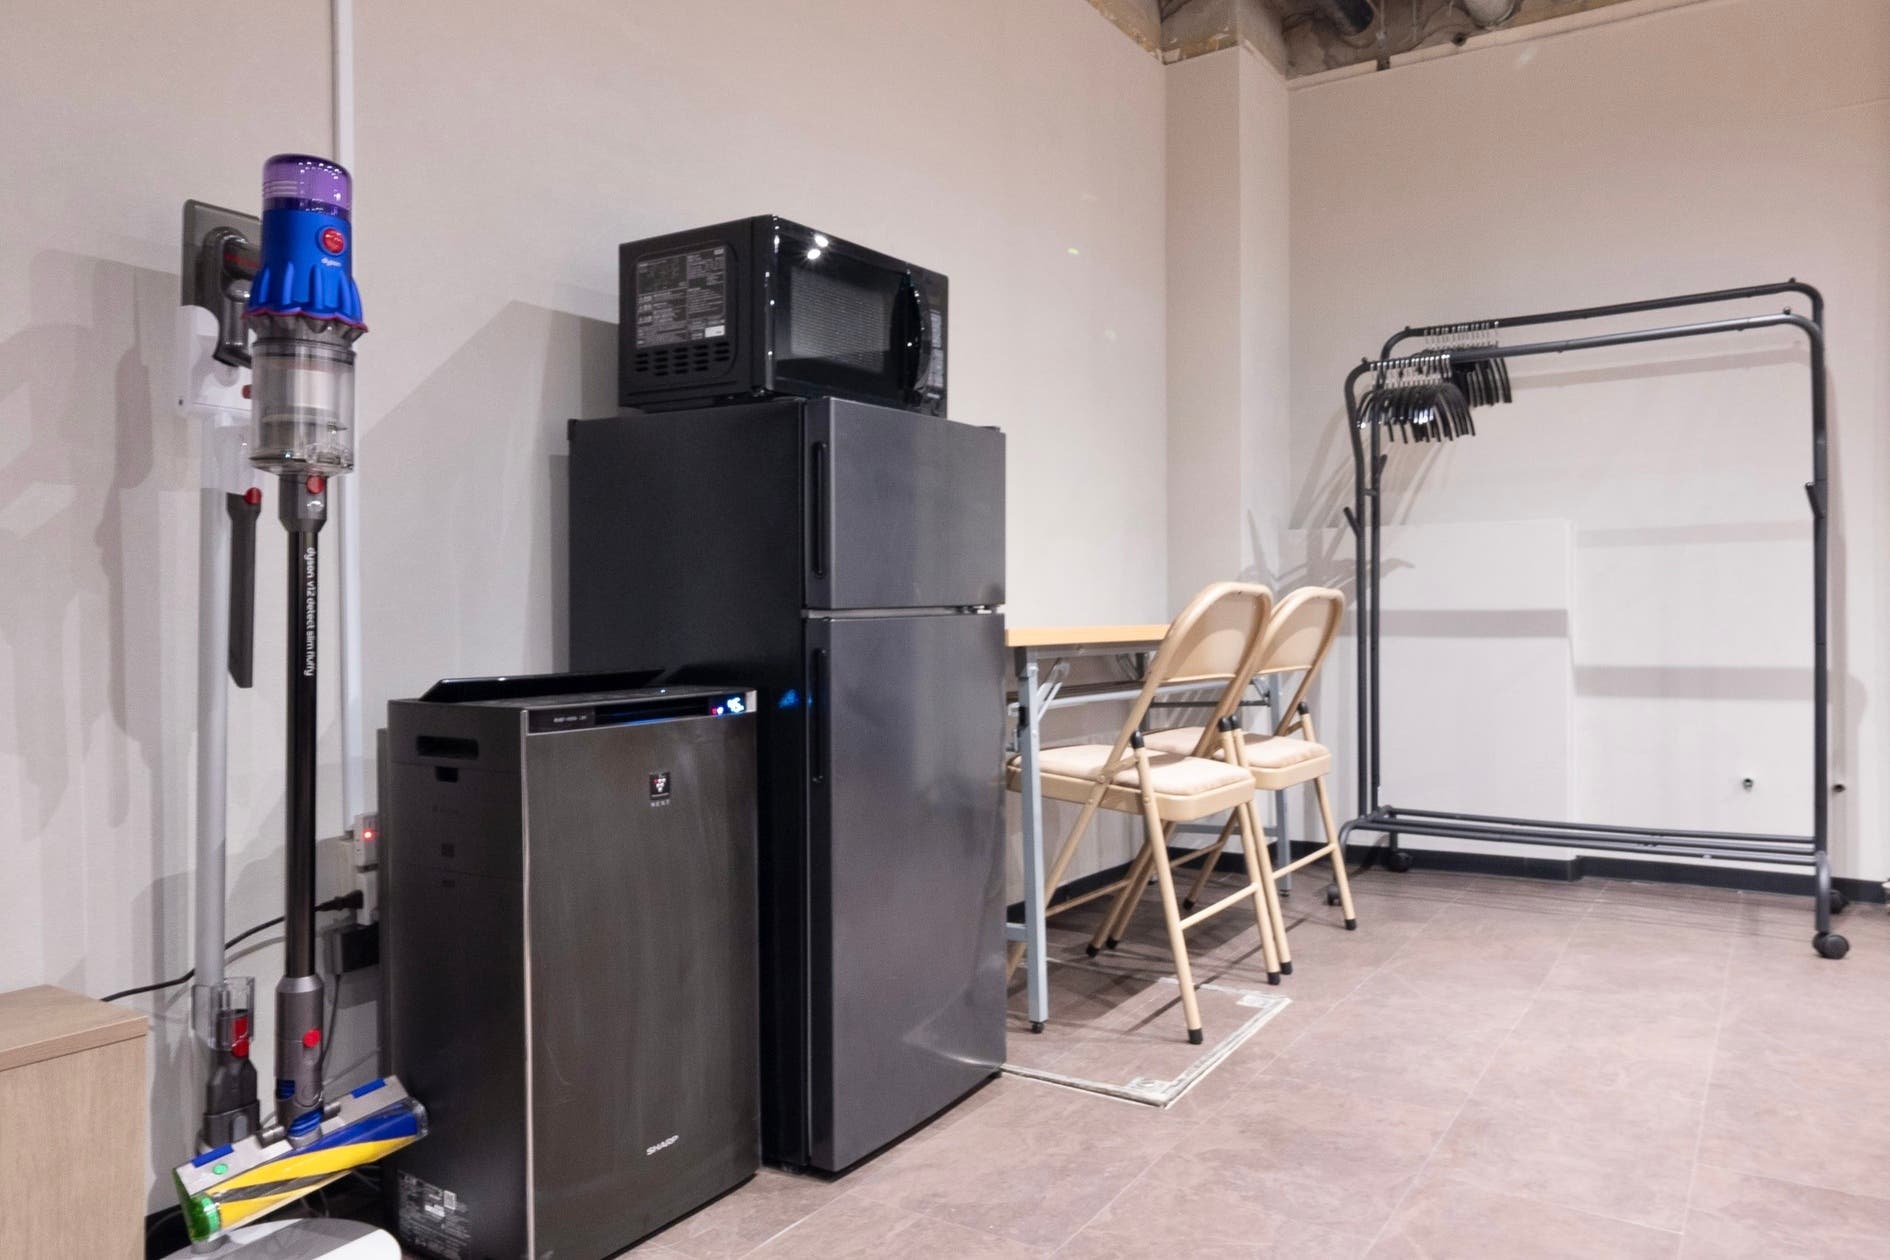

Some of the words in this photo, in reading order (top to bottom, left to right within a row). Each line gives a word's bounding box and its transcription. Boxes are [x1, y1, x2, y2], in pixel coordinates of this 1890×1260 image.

[303, 547, 316, 577] dyson
[307, 580, 316, 596] v12
[307, 597, 316, 630] detect
[306, 631, 315, 649] slim
[303, 650, 315, 677] fluffy
